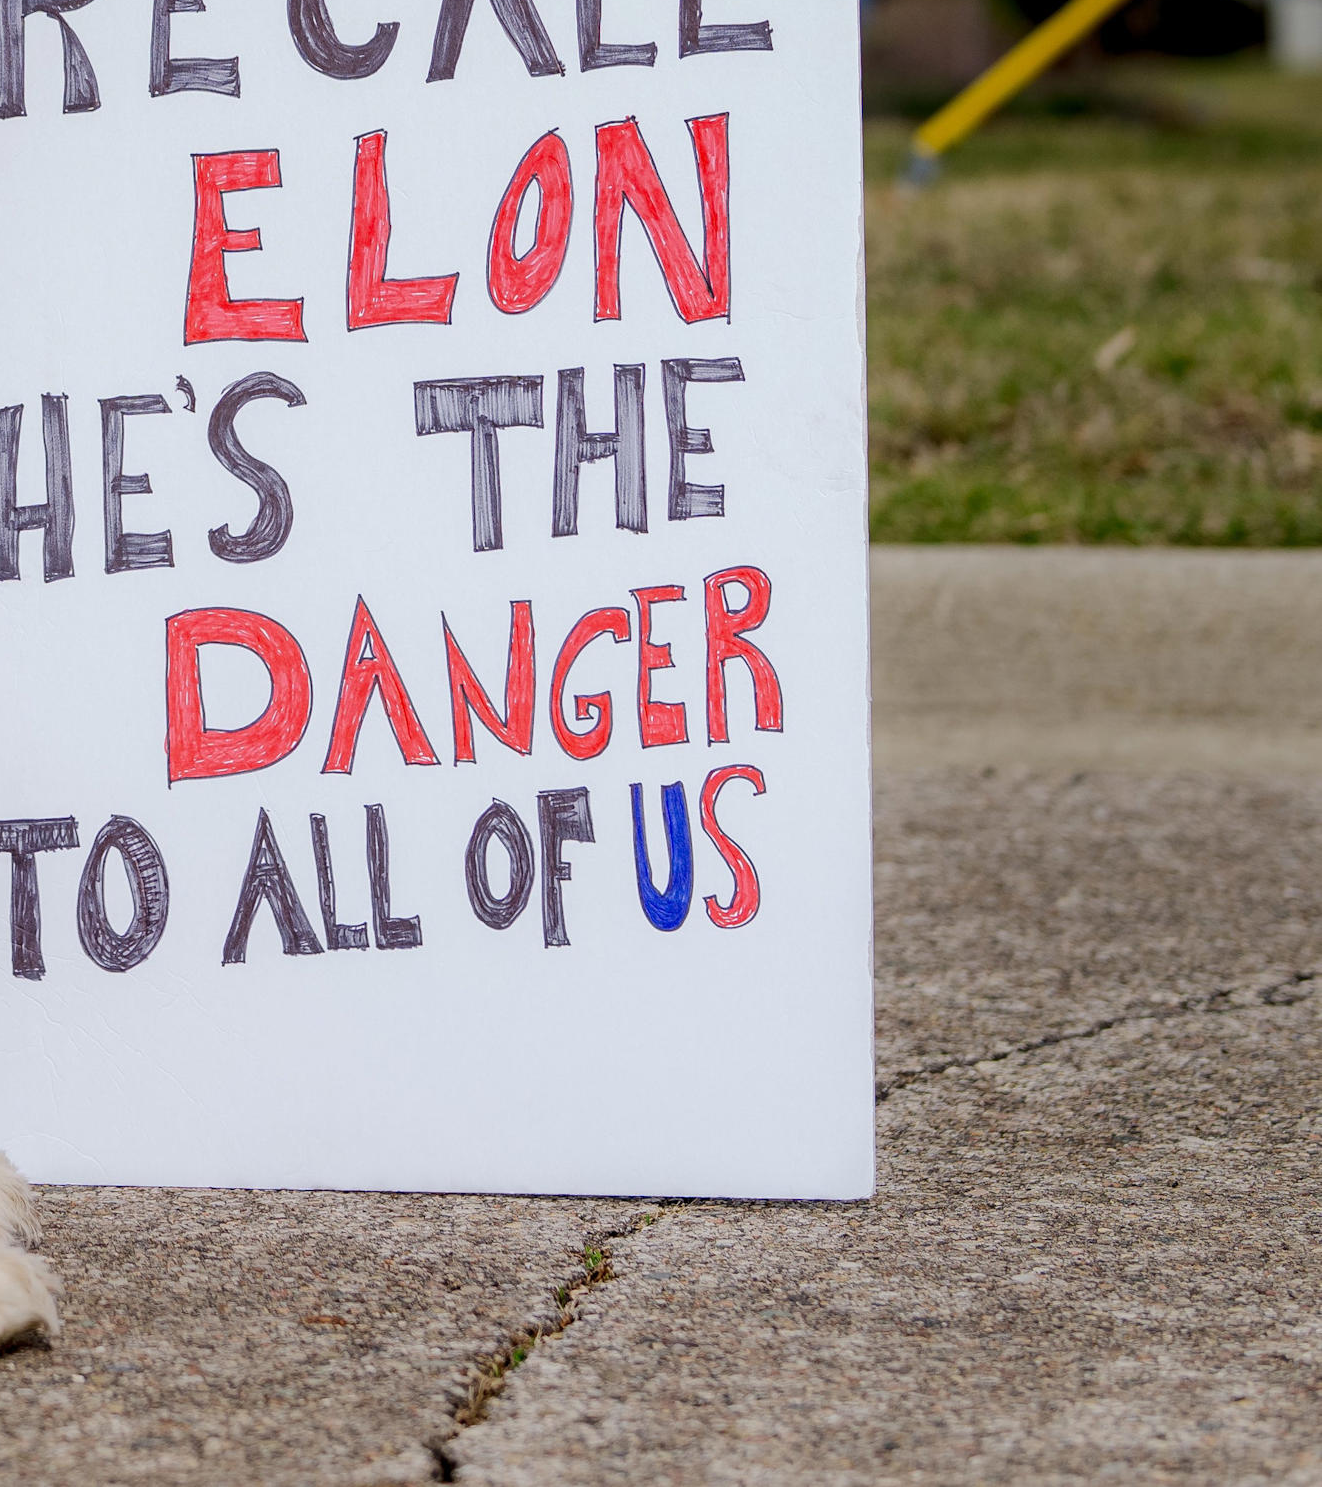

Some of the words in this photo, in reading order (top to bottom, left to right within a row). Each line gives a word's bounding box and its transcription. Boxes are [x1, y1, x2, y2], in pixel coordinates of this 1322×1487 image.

[183, 112, 732, 346] ELON
[414, 357, 746, 553] THE
[164, 565, 784, 789] DANGER
[221, 803, 423, 966] ALL
[465, 787, 596, 948] OF
[629, 764, 767, 932] US
